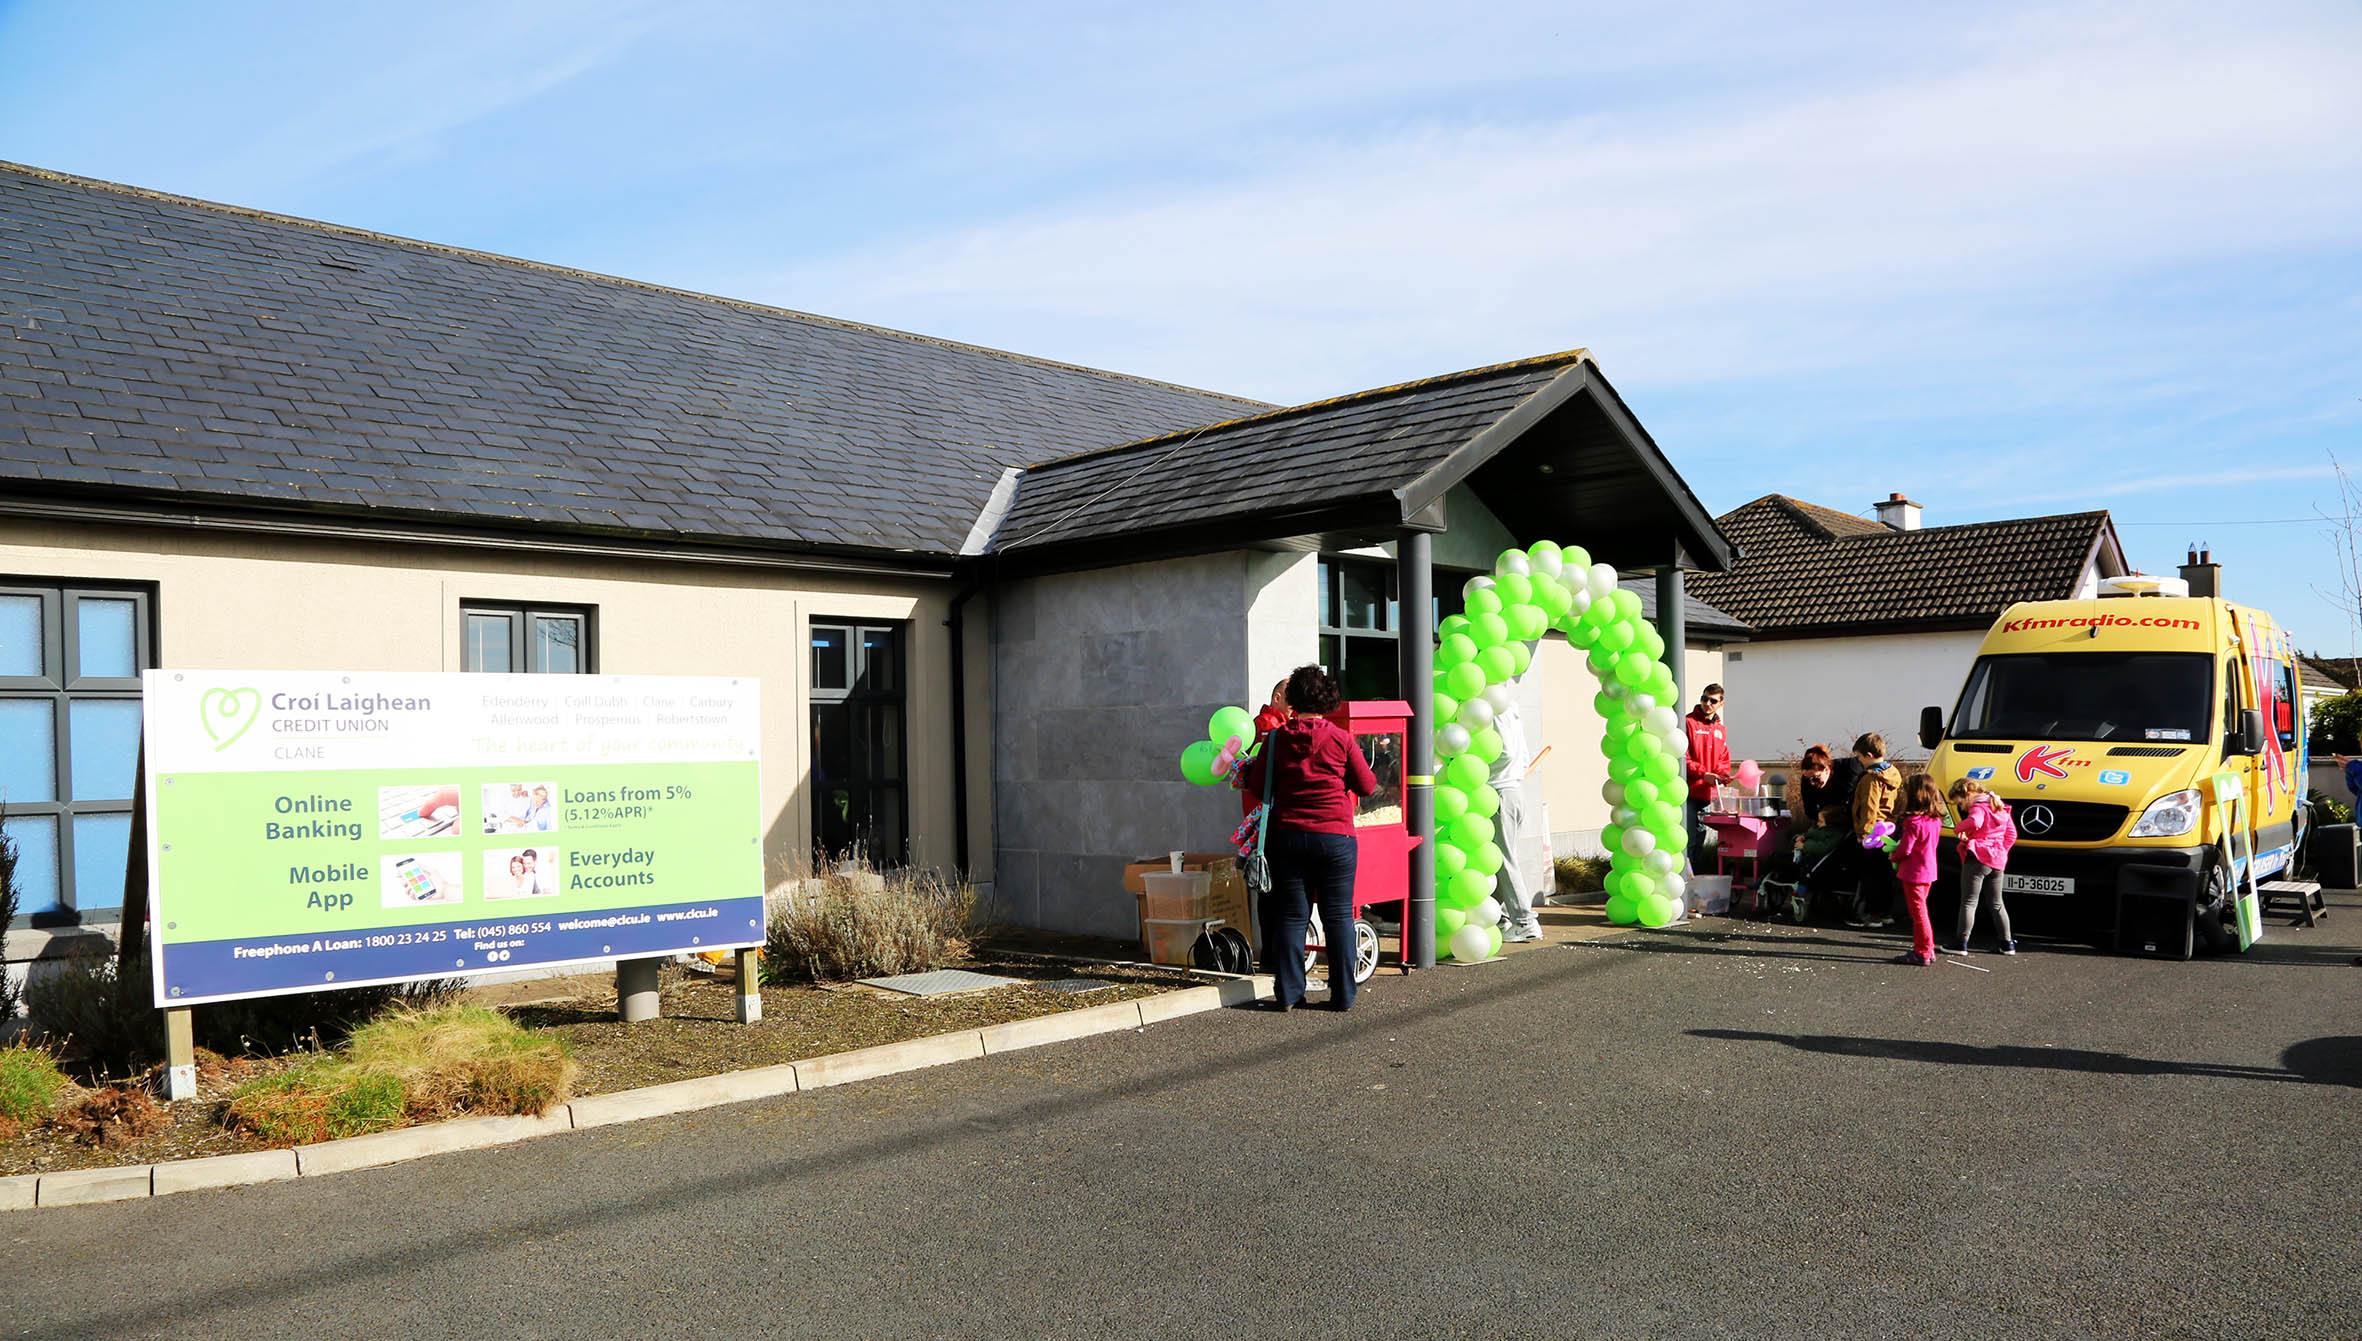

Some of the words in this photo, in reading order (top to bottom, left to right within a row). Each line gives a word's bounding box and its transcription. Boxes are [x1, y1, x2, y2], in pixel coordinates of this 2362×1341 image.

[2002, 614, 2201, 633] Kfmradio.com
[271, 692, 320, 711] Croí
[327, 692, 431, 715] Laighean
[272, 719, 331, 732] CREDIT
[335, 719, 389, 732] UNION
[656, 713, 728, 726] Robertstown
[274, 747, 325, 760] CLANE
[2015, 744, 2092, 782] Kfm
[565, 788, 616, 804] Loans
[620, 786, 661, 802] from
[666, 785, 692, 800] 5%
[274, 795, 352, 814] Online
[265, 820, 362, 841] Banking
[570, 848, 655, 869] Everyday
[289, 864, 369, 884] Mobile
[570, 871, 655, 890] Accounts
[2007, 877, 2065, 892] 11-D-36025
[306, 891, 354, 911] App
[233, 943, 310, 959] Freephone
[312, 940, 323, 953] A
[325, 938, 363, 951] Loan:
[365, 934, 395, 948] 1800
[397, 932, 412, 945] 23
[414, 931, 430, 944] 24
[432, 930, 447, 942] 25
[453, 928, 476, 940] Tel:
[477, 925, 506, 939] (045)
[508, 923, 529, 935] 860
[531, 921, 552, 934] 554
[558, 913, 652, 931] welcome@clcu.ie
[656, 906, 719, 922] www.clcu.ie
[474, 940, 496, 951] Find
[497, 941, 508, 950] us
[509, 939, 525, 949] on:
